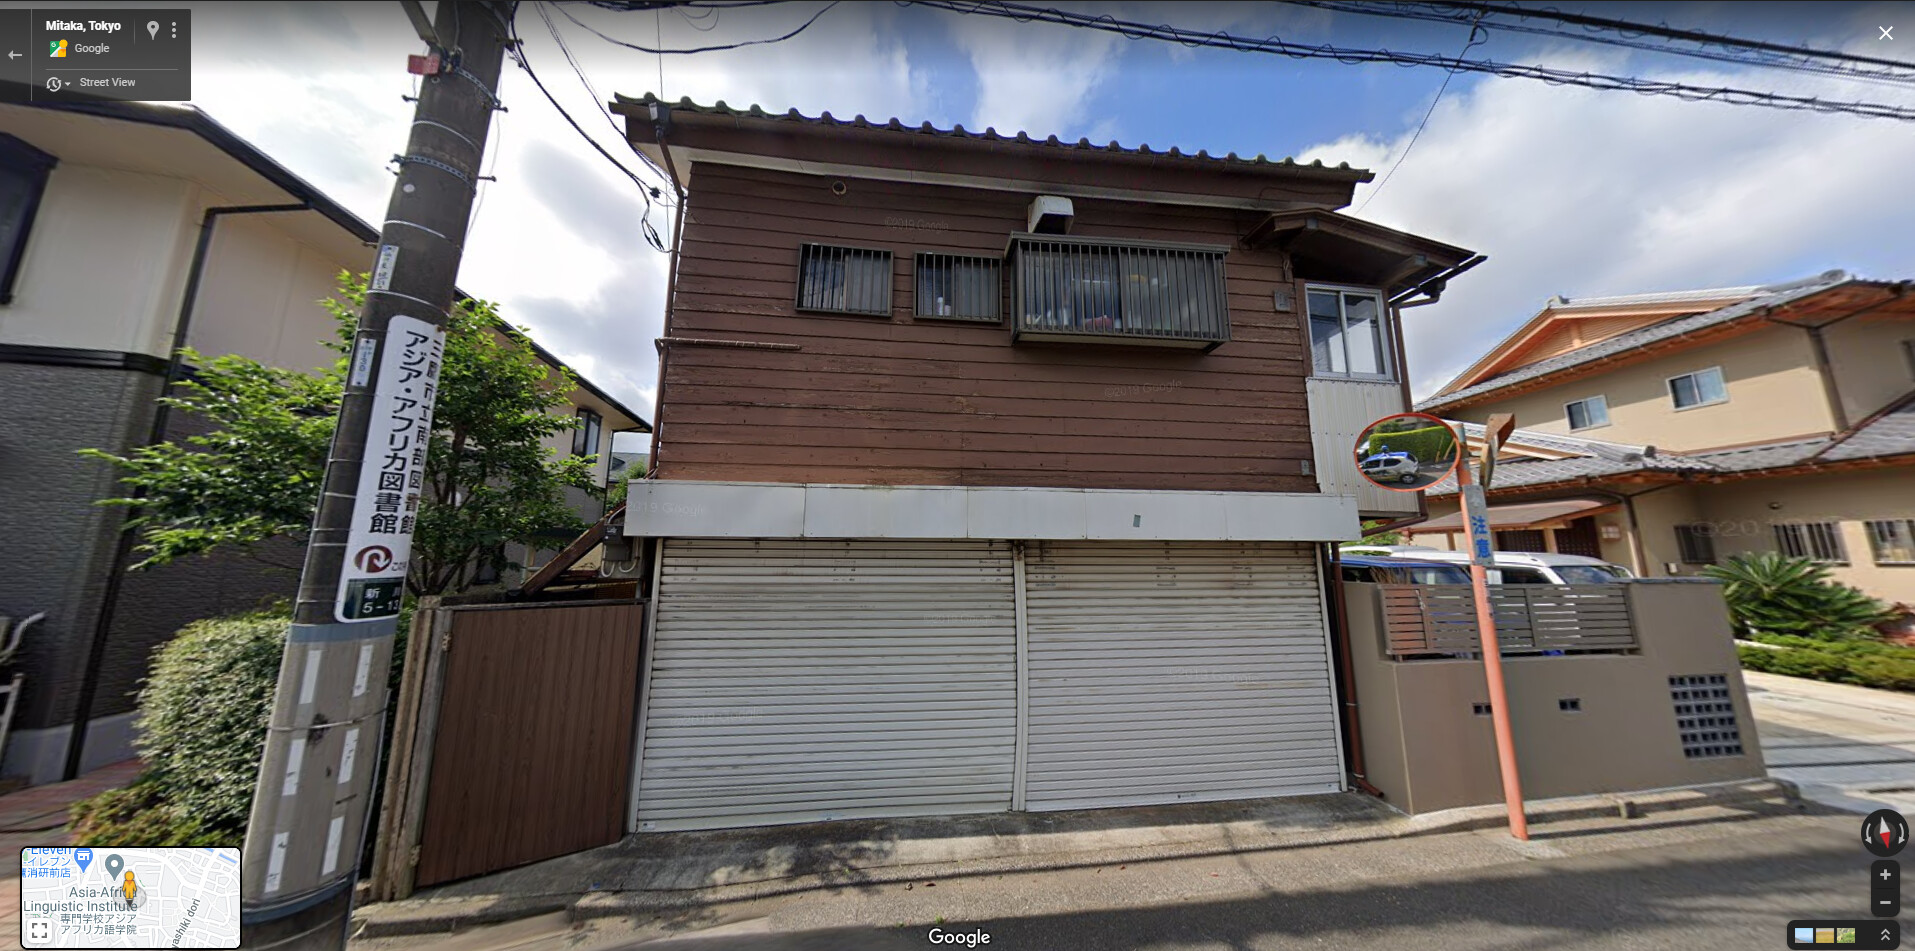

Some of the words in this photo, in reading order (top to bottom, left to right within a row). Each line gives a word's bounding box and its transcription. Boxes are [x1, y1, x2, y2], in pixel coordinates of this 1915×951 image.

[369, 330, 429, 534] アジア・アフリカ図書館
[1471, 515, 1491, 558] 注意
